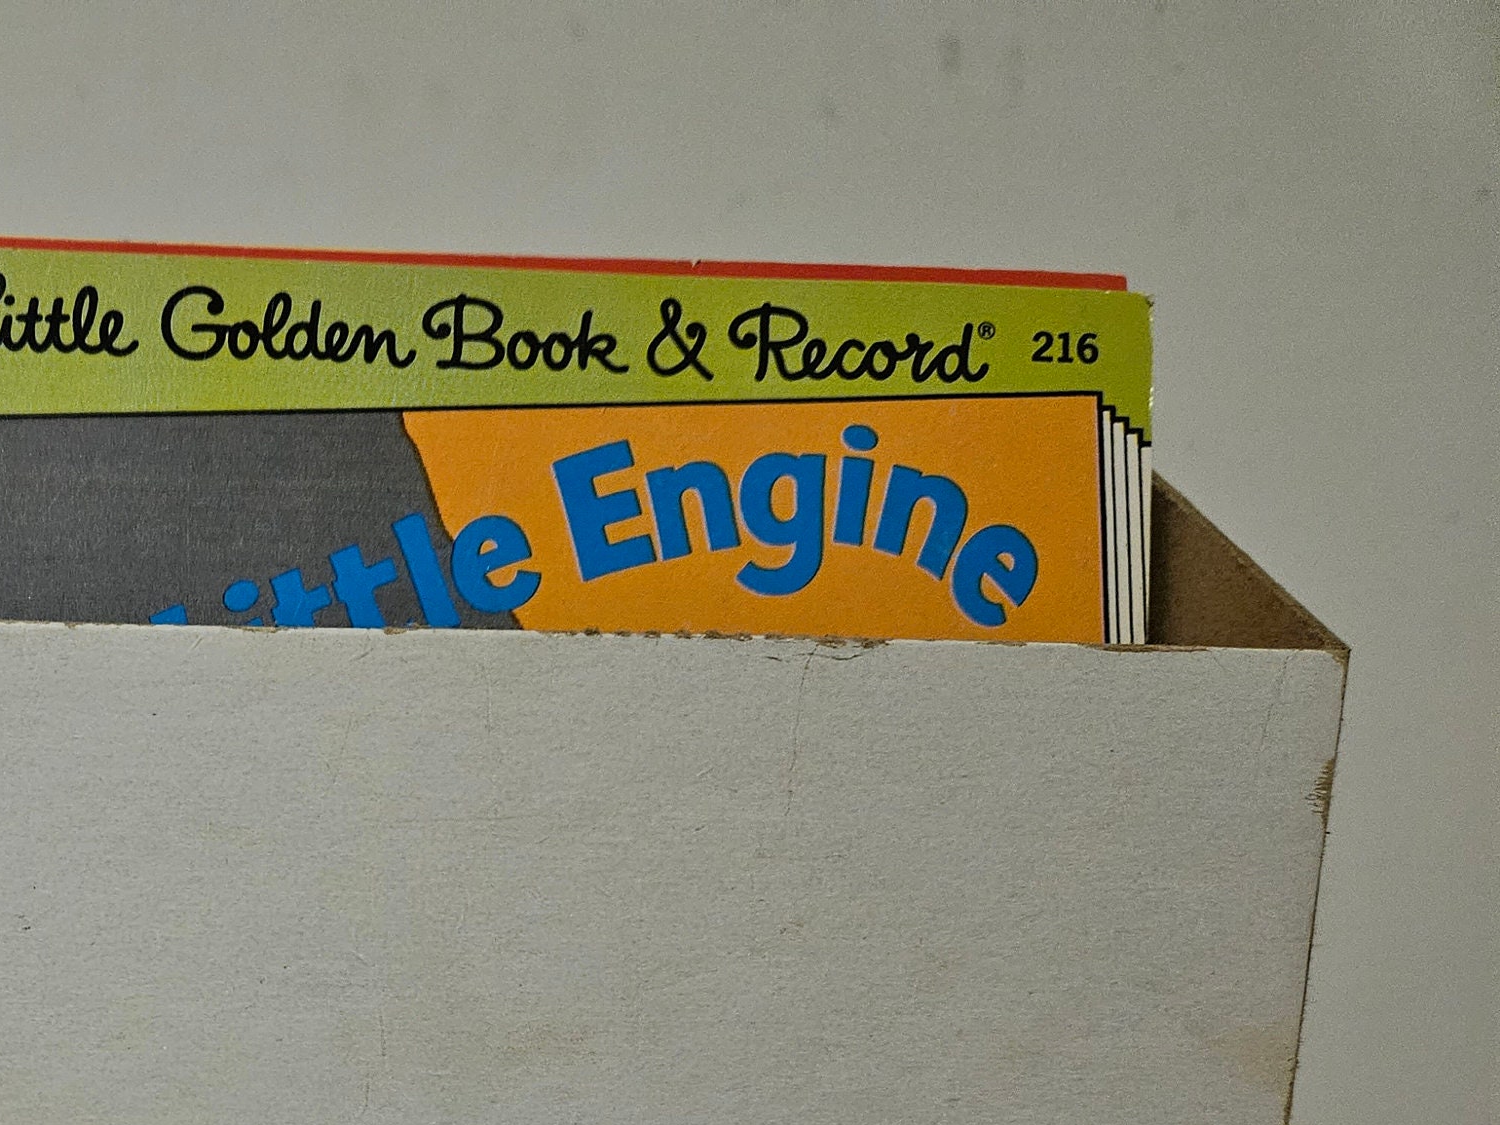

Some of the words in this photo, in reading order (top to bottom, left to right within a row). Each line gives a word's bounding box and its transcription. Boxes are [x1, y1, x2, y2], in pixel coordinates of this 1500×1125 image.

[160, 286, 416, 366] Golden
[422, 294, 628, 373] Book
[646, 298, 715, 381] &
[1031, 330, 1099, 364] 216
[552, 424, 1040, 628] Engine
